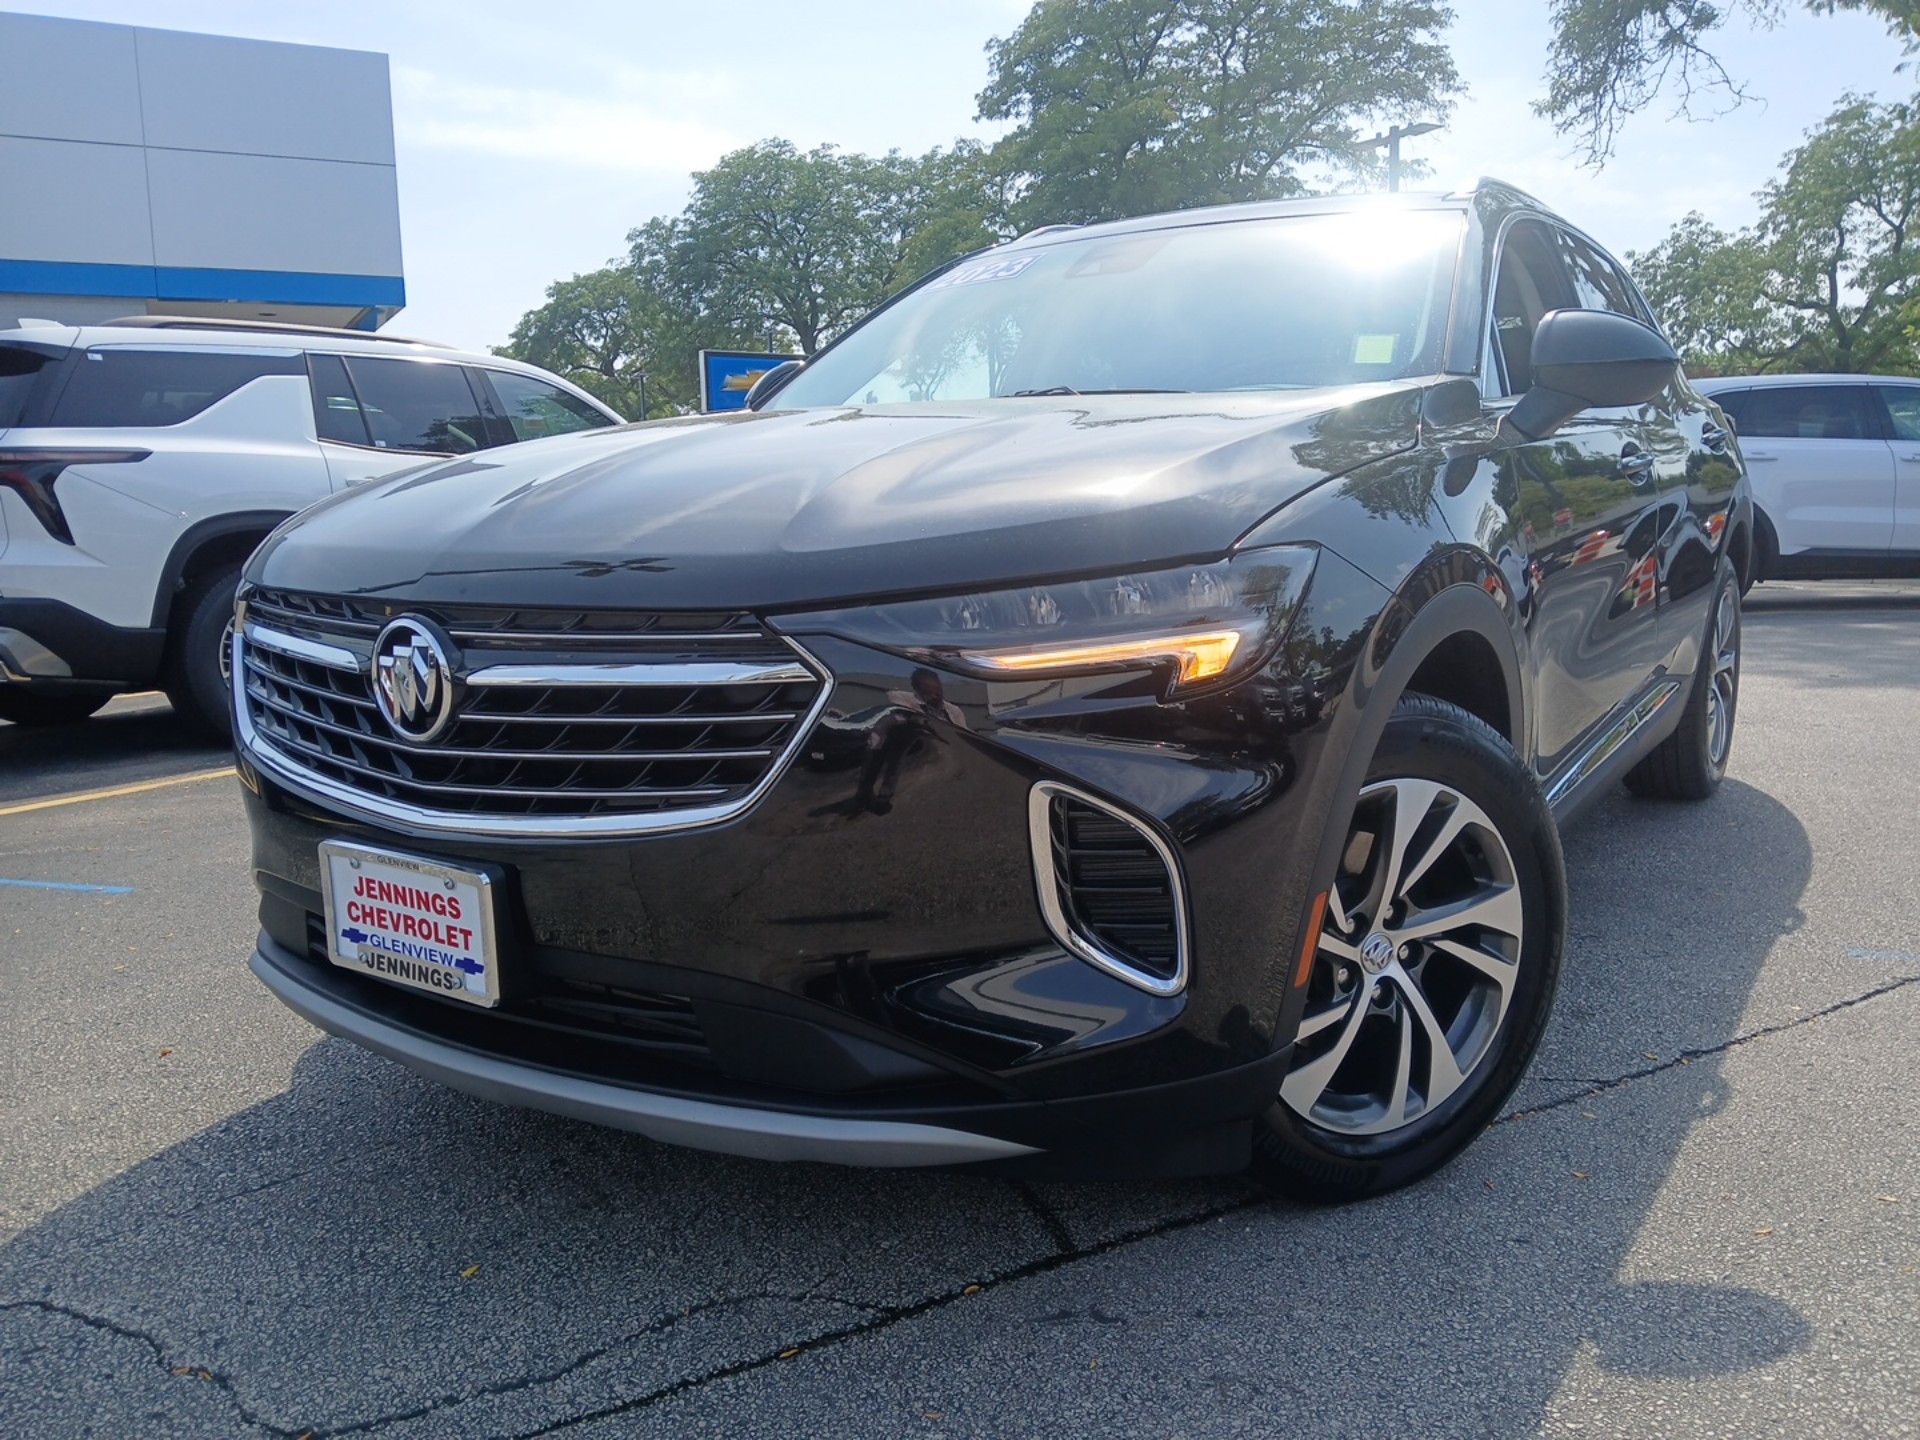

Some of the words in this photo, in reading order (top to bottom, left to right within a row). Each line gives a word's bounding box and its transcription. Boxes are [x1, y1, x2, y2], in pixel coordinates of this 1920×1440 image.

[929, 257, 1035, 290] 2023
[376, 855, 420, 871] GLENVIEW
[354, 876, 461, 919] JENNINGS
[347, 902, 472, 951] CHEVROLET
[370, 934, 454, 966] GLENVIEW
[367, 953, 454, 990] JENNINGS
